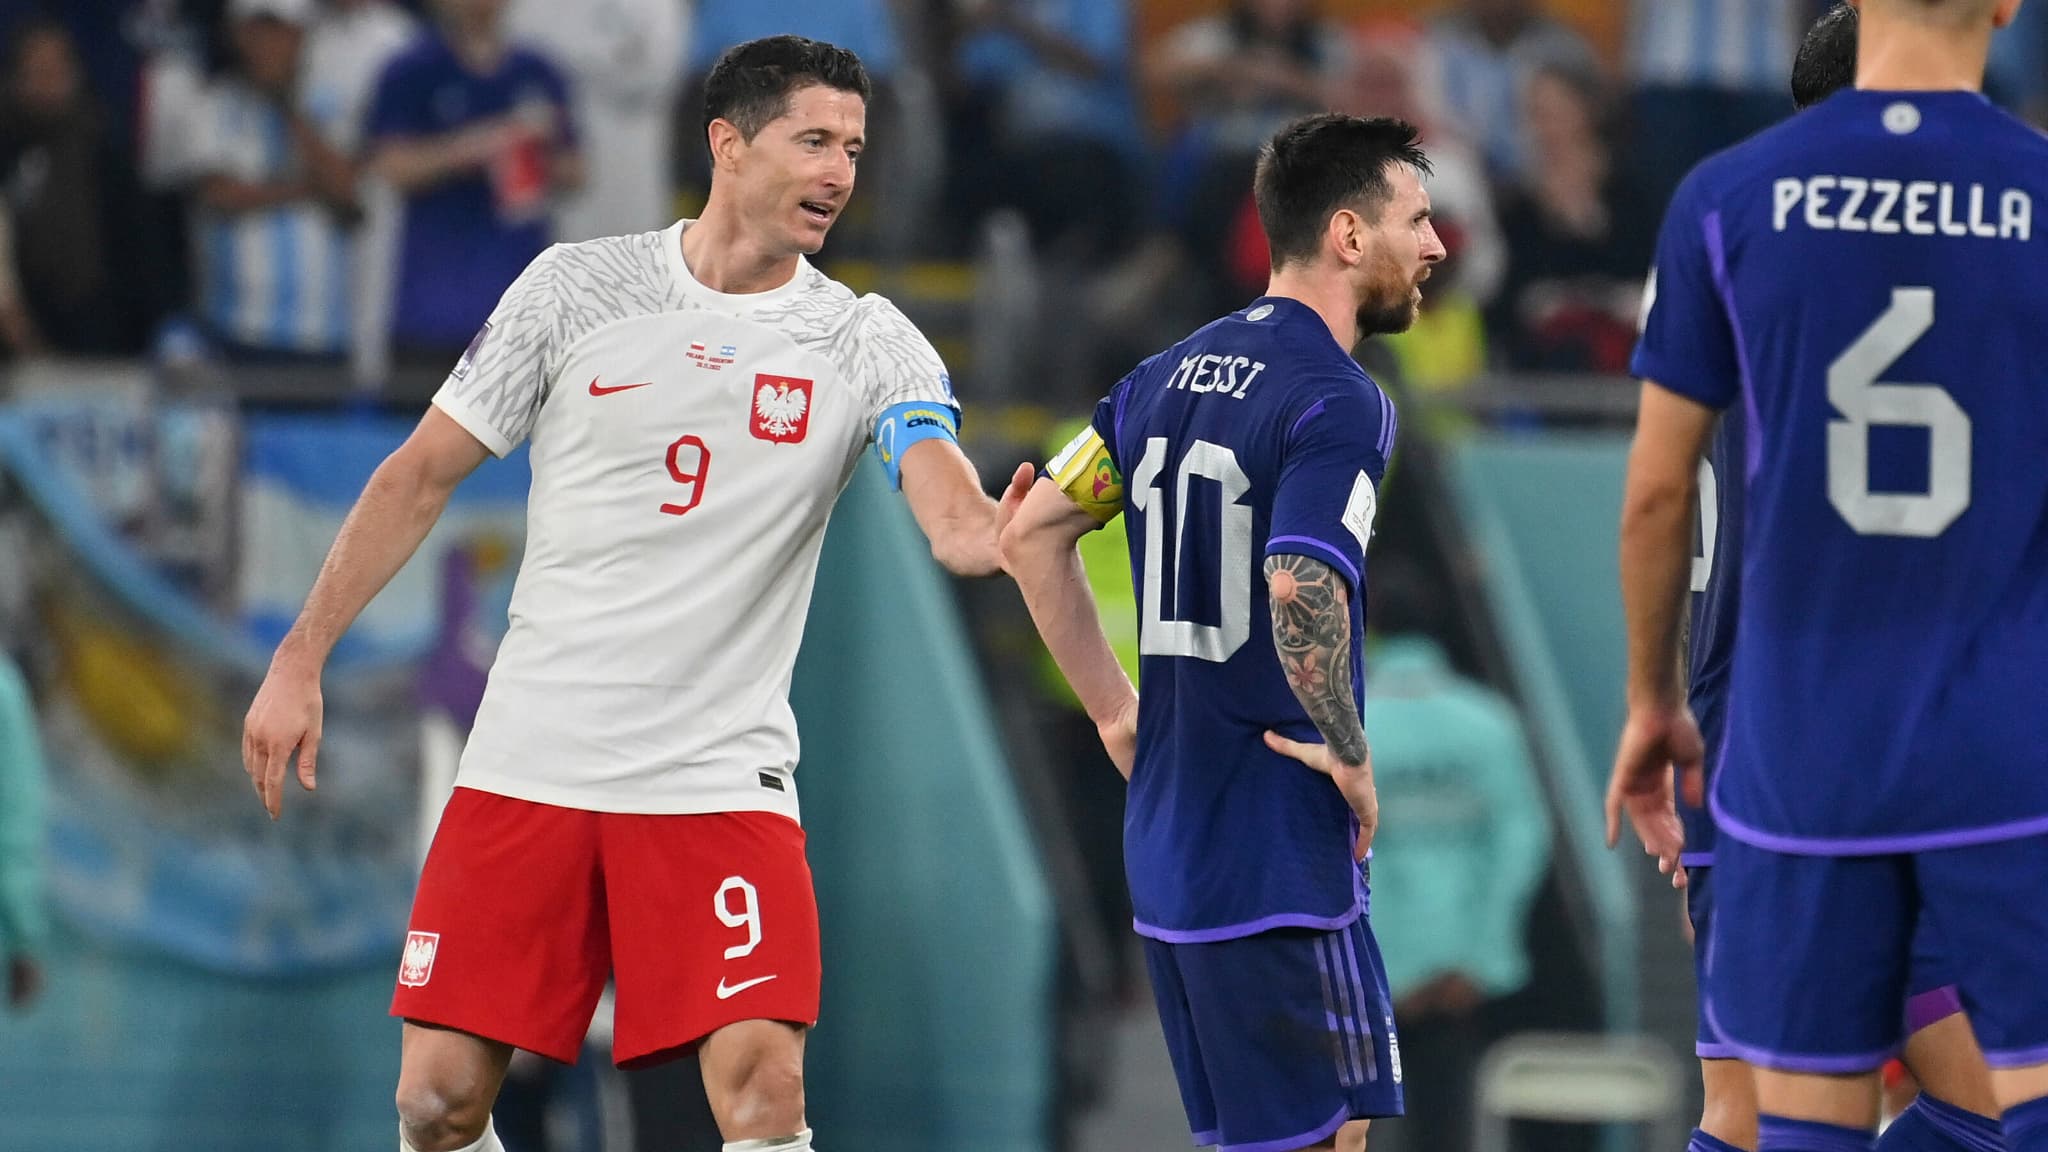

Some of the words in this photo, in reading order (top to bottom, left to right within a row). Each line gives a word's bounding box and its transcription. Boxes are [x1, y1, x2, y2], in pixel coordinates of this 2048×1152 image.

[1773, 175, 2032, 241] PEZZELLA
[1166, 353, 1266, 400] MESSI
[1826, 285, 1972, 539] 6
[660, 434, 711, 516] 9
[1132, 437, 1252, 663] 10
[713, 875, 762, 961] 9
